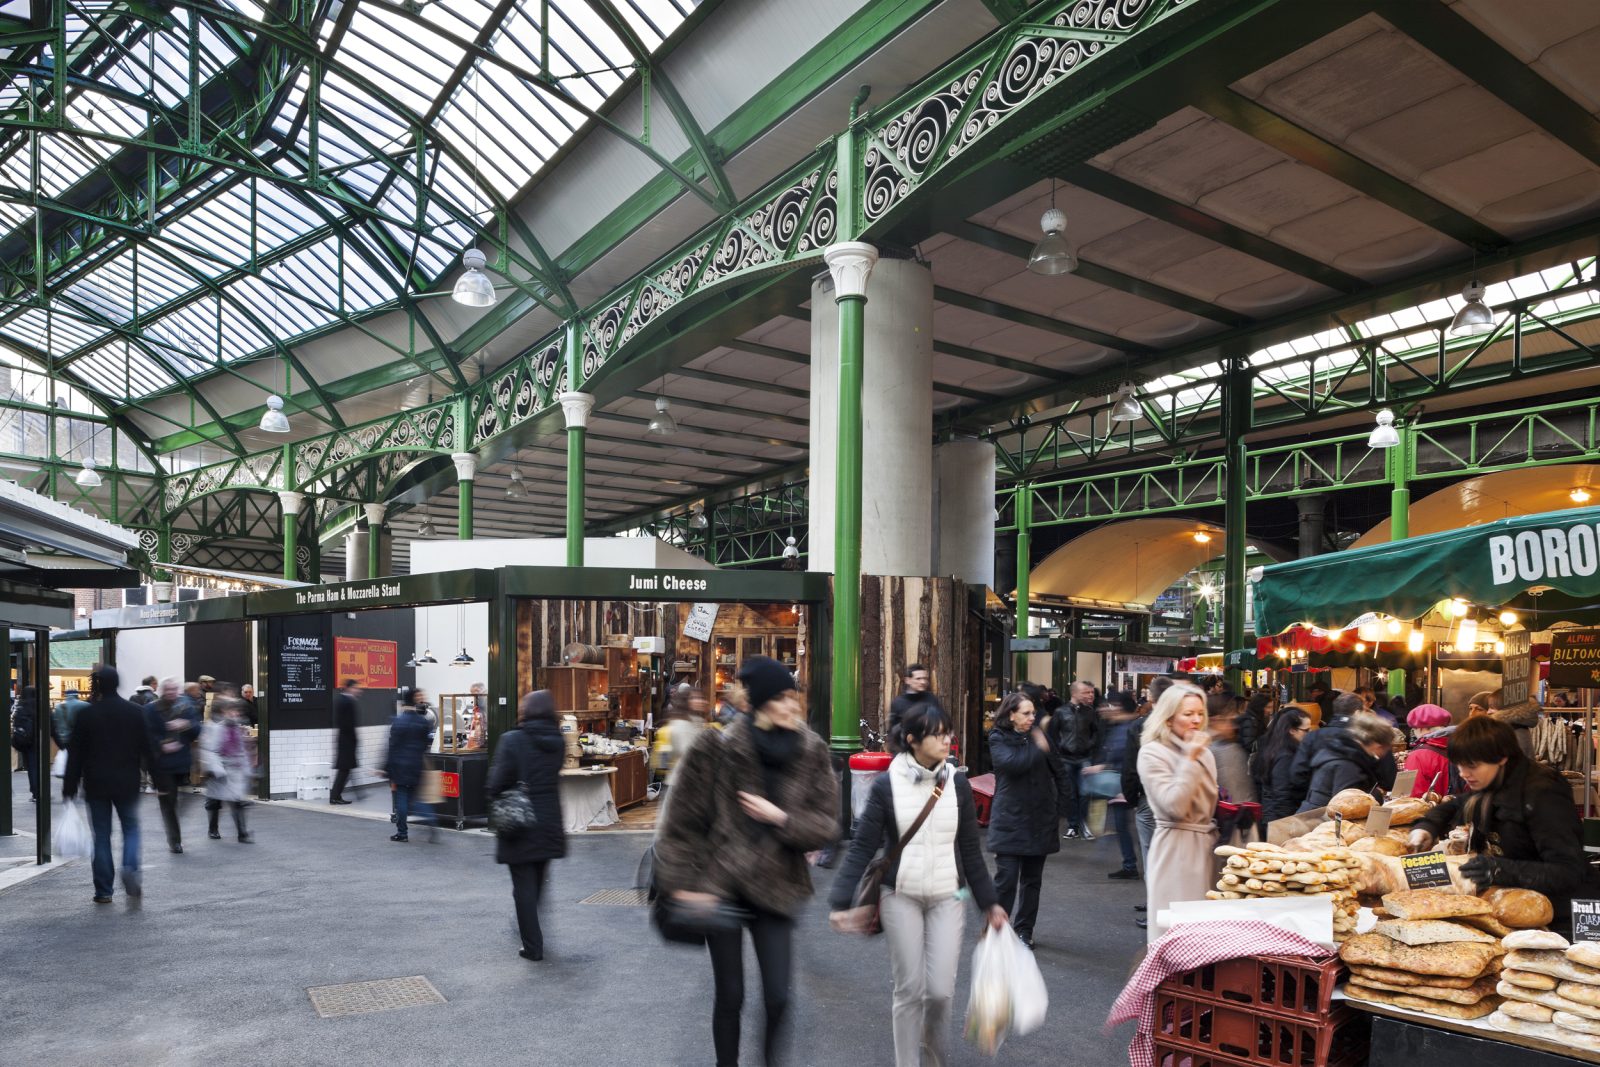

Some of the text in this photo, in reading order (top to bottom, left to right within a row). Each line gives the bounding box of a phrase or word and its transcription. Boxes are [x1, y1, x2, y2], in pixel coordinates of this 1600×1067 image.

[1489, 523, 1600, 586] BORO
[629, 574, 707, 591] Jumi Cheese
[296, 582, 401, 604] The Parma Ham & Mozzarella Stand
[1505, 634, 1530, 657] BREAD
[1566, 634, 1596, 644] ALPINE
[369, 664, 393, 675] BUFALA
[1505, 657, 1529, 681] AHEAD
[1504, 681, 1528, 706] BAKERY
[1401, 853, 1446, 869] Focaccia
[1572, 901, 1594, 914] Bread
